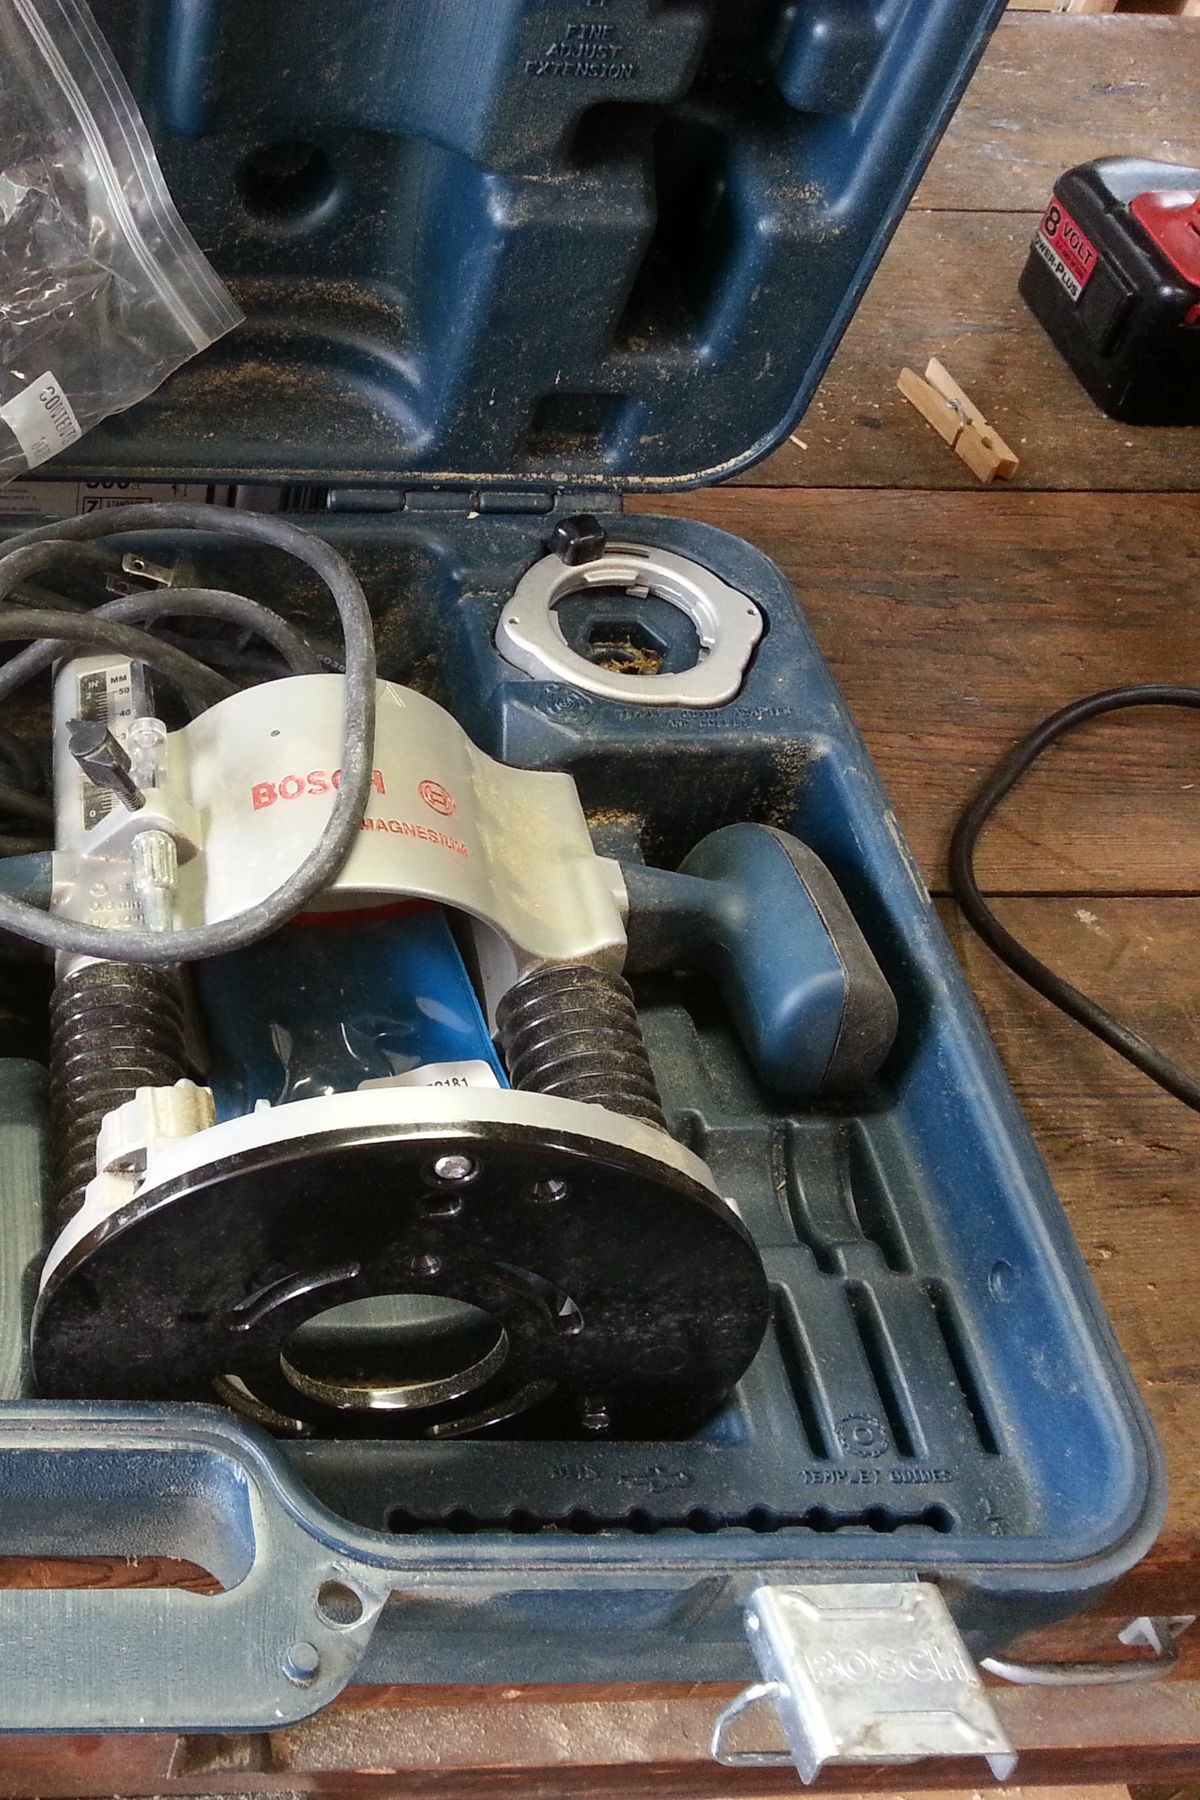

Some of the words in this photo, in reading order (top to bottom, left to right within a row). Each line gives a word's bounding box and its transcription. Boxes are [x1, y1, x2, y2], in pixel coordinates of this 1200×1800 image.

[565, 23, 616, 40] FINE
[545, 42, 623, 58] ADJUST
[524, 60, 634, 79] EXTENSION
[1062, 221, 1094, 265] VOLT
[88, 681, 98, 689] IN
[110, 675, 127, 684] MM
[118, 686, 130, 695] 50
[119, 708, 131, 717] 40
[359, 816, 468, 858] MAGNESIUM
[804, 1645, 969, 1685] BOSCH
